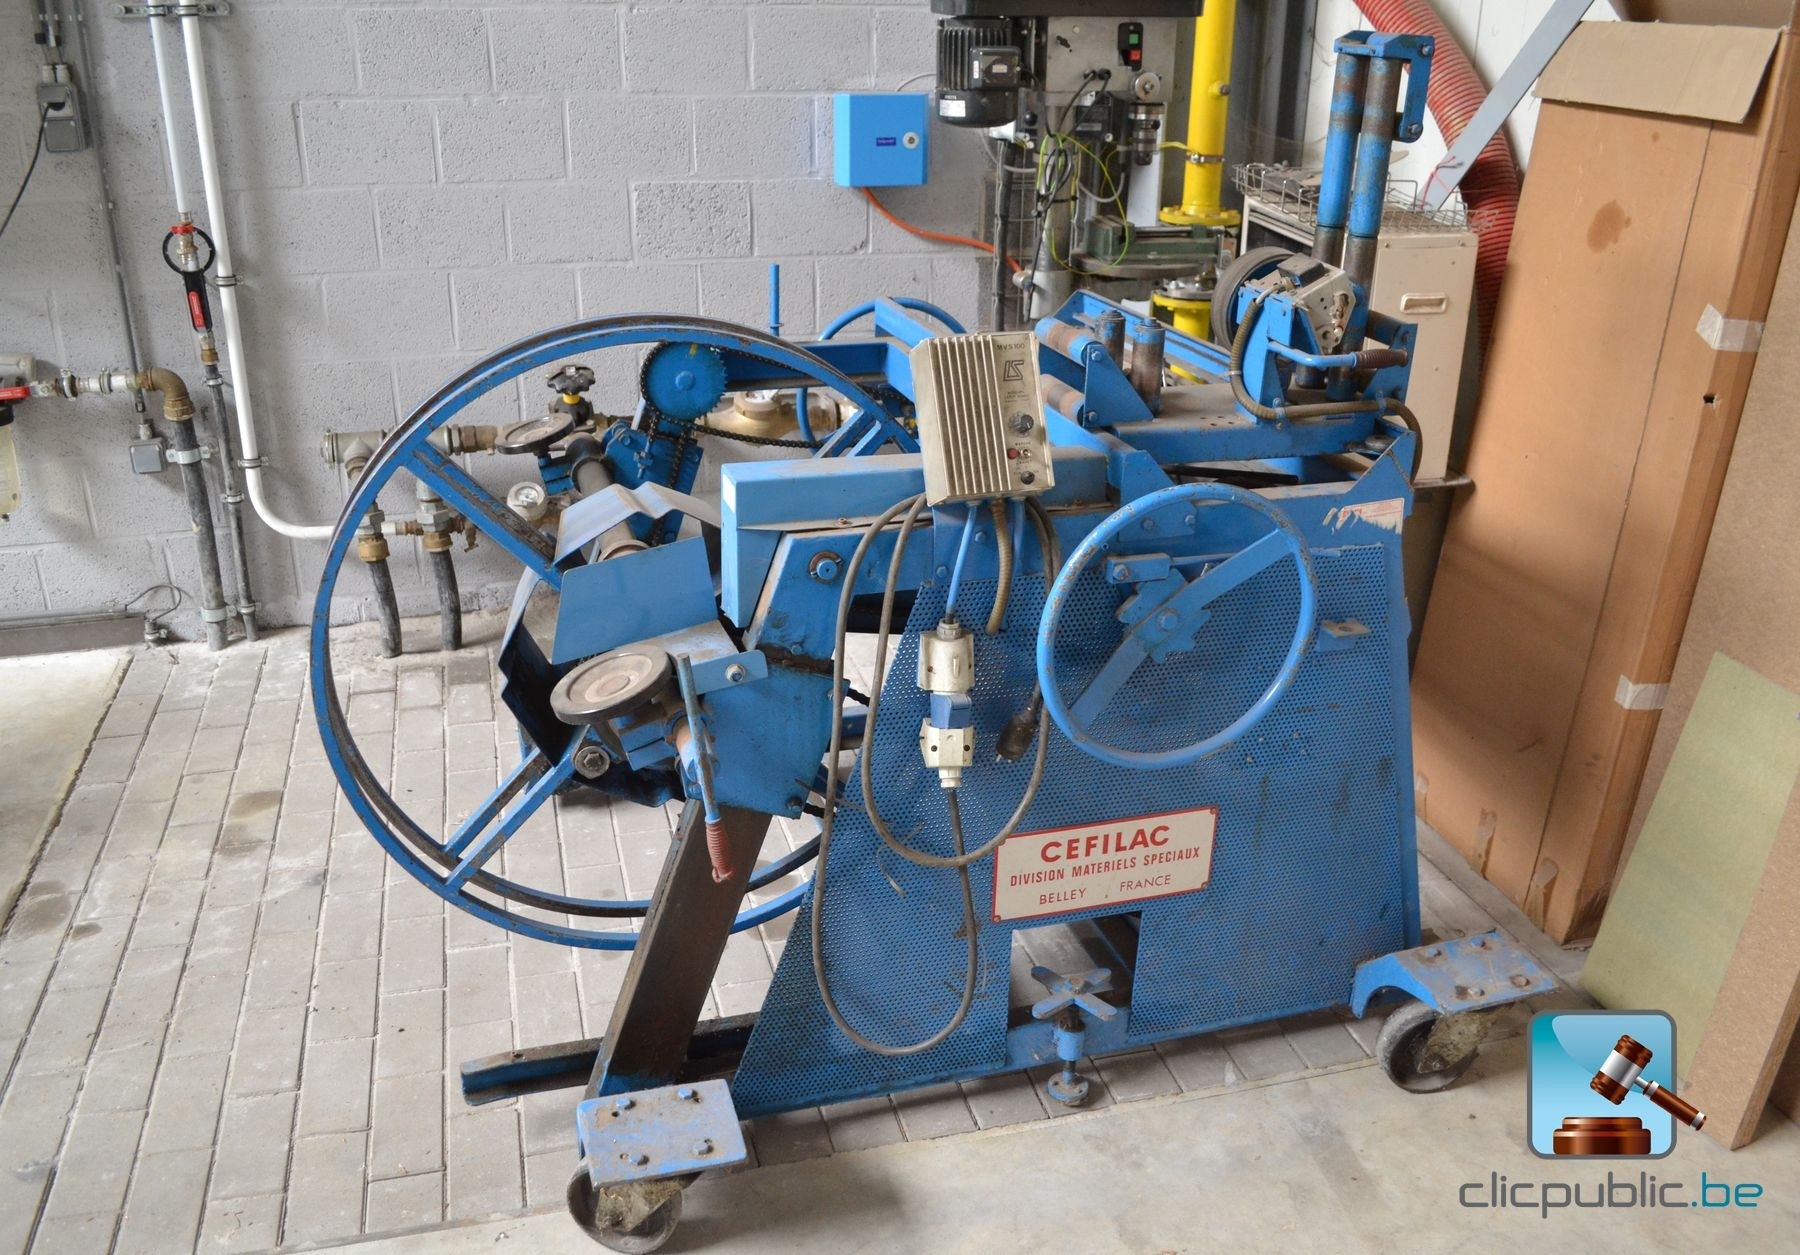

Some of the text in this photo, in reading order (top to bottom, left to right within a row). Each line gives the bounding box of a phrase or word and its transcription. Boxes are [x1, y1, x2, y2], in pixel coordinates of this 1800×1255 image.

[1040, 825, 1170, 863] CEFILAC
[1010, 846, 1201, 887] DIVISION MATERIELS SPECIAUX
[1039, 874, 1172, 905] BELLEY FRANCE
